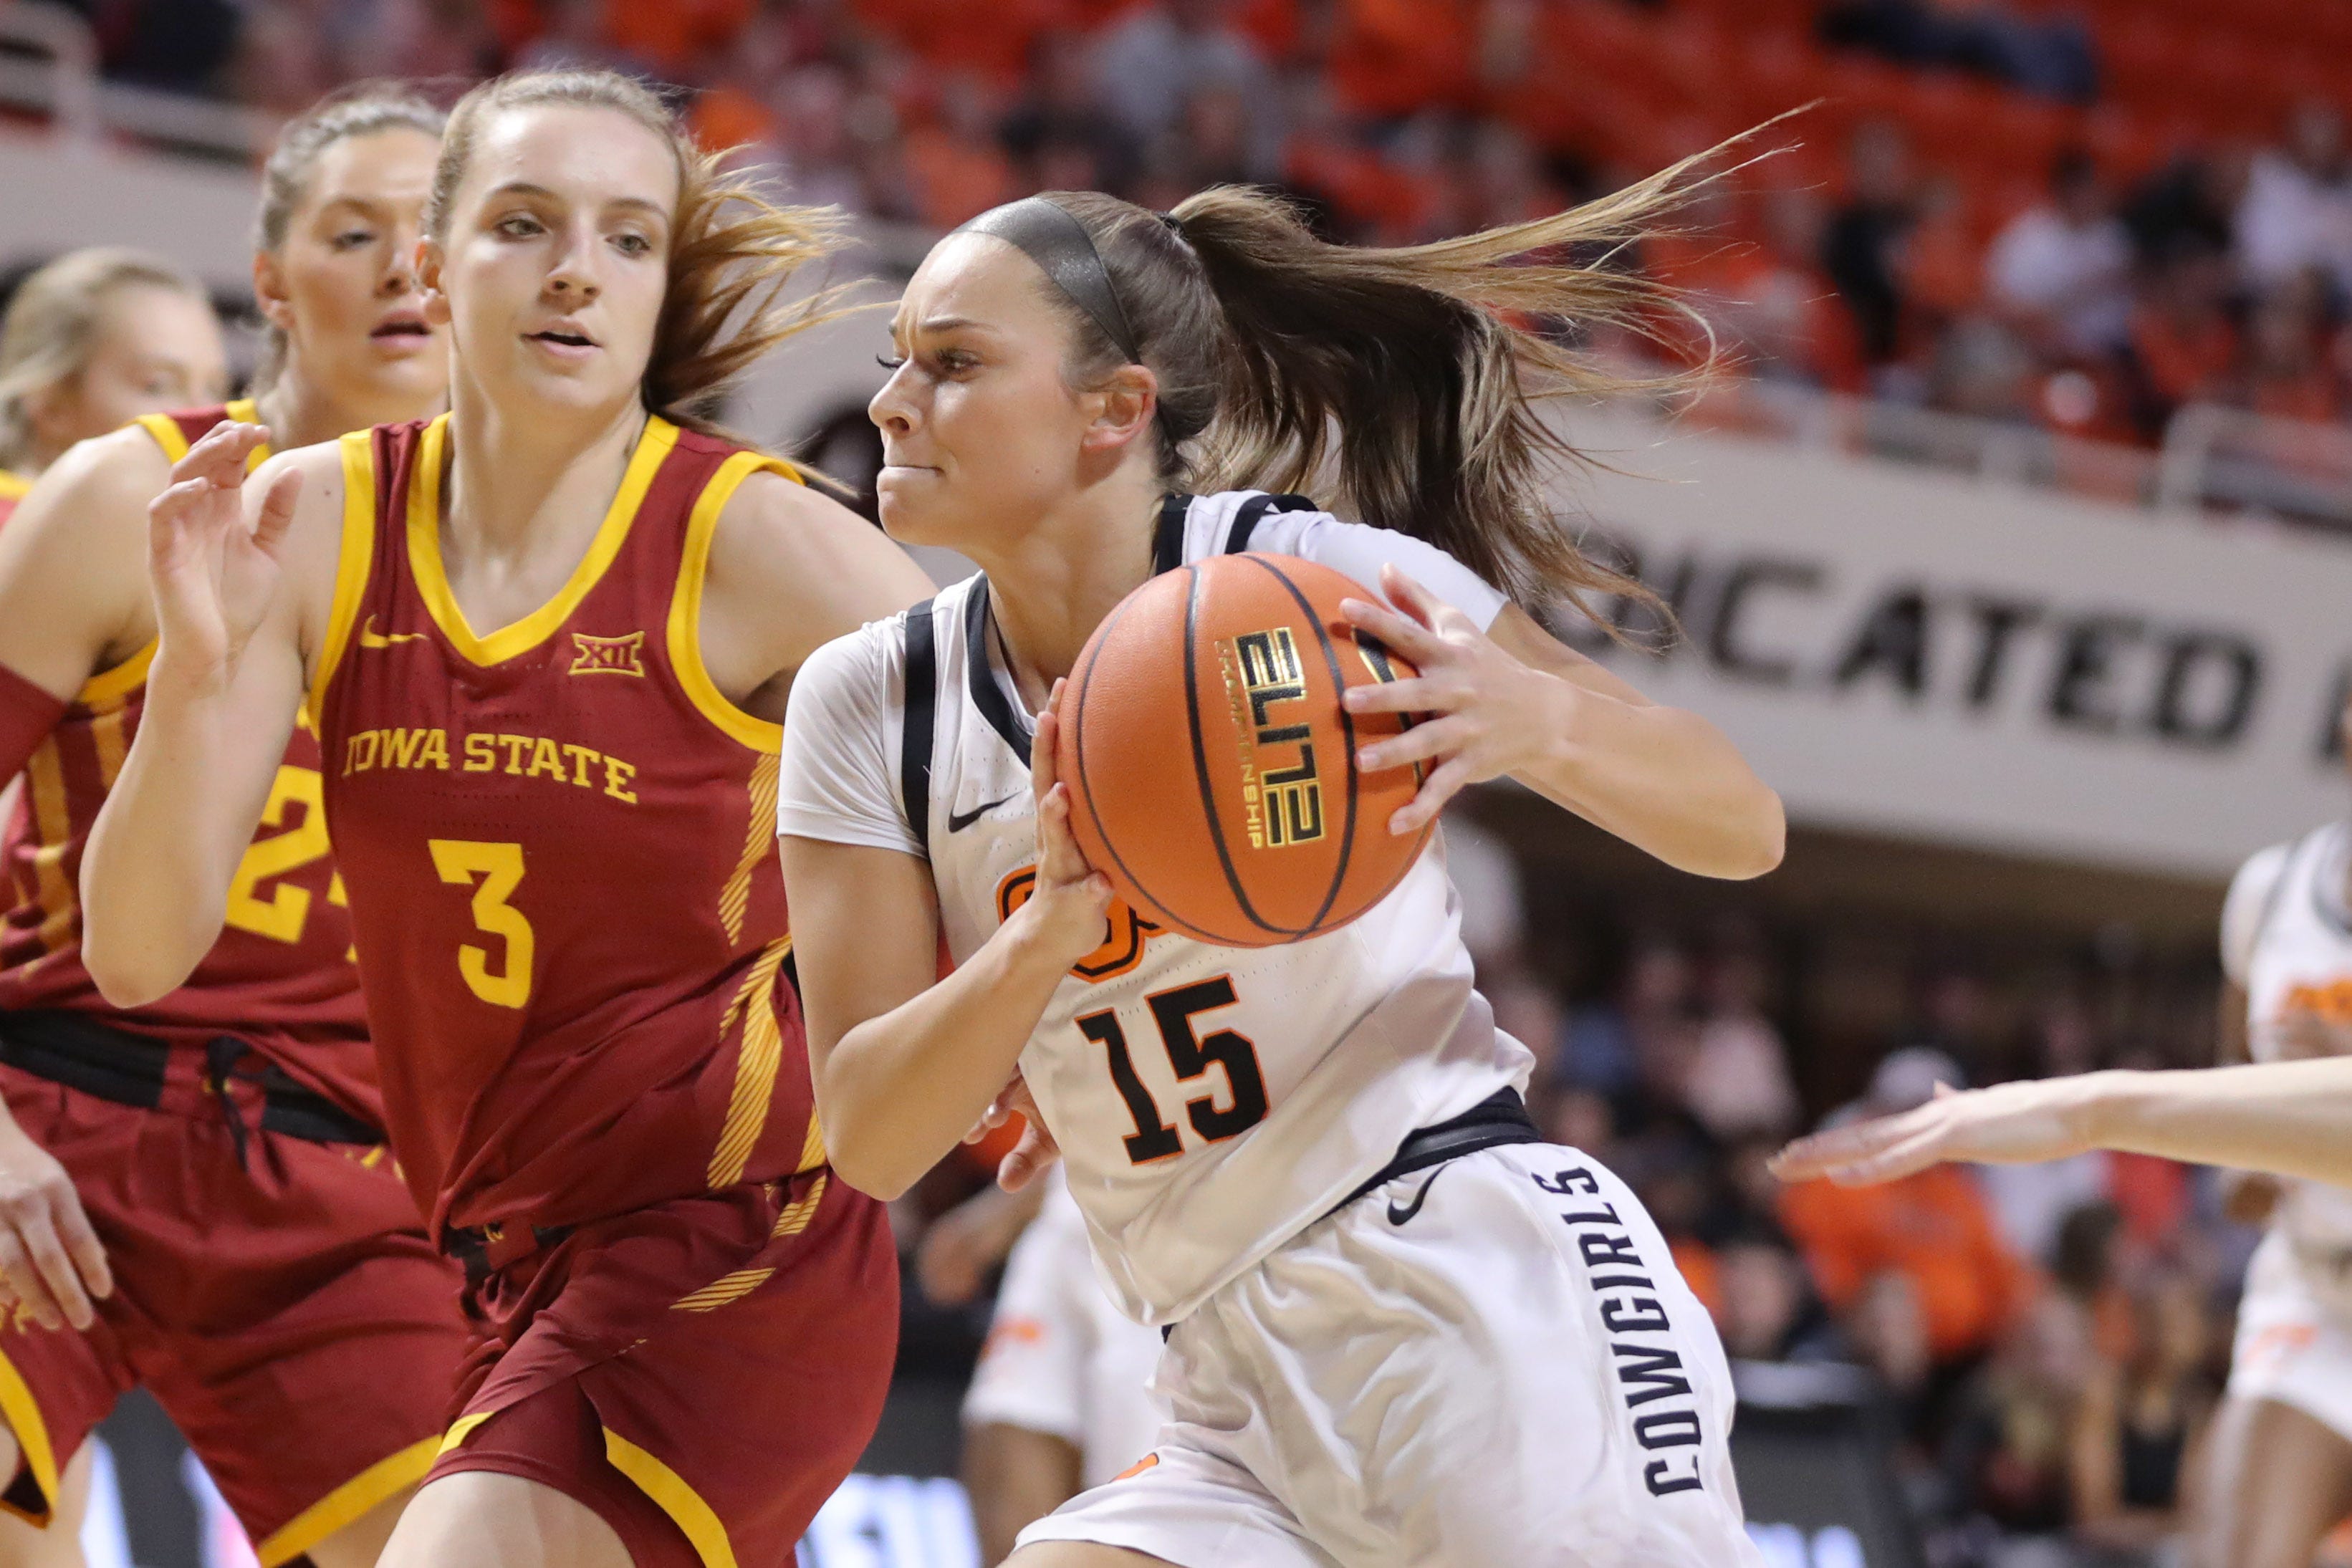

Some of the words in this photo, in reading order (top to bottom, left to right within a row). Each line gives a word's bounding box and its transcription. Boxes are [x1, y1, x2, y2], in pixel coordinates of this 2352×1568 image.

[342, 728, 451, 779] IOWA
[463, 733, 638, 804] STATE
[1232, 627, 1325, 847] ELITE
[225, 764, 357, 963] 2
[428, 839, 534, 1009] 3
[1075, 973, 1270, 1165] 15
[1531, 1166, 1704, 1497] COWGIRLS
